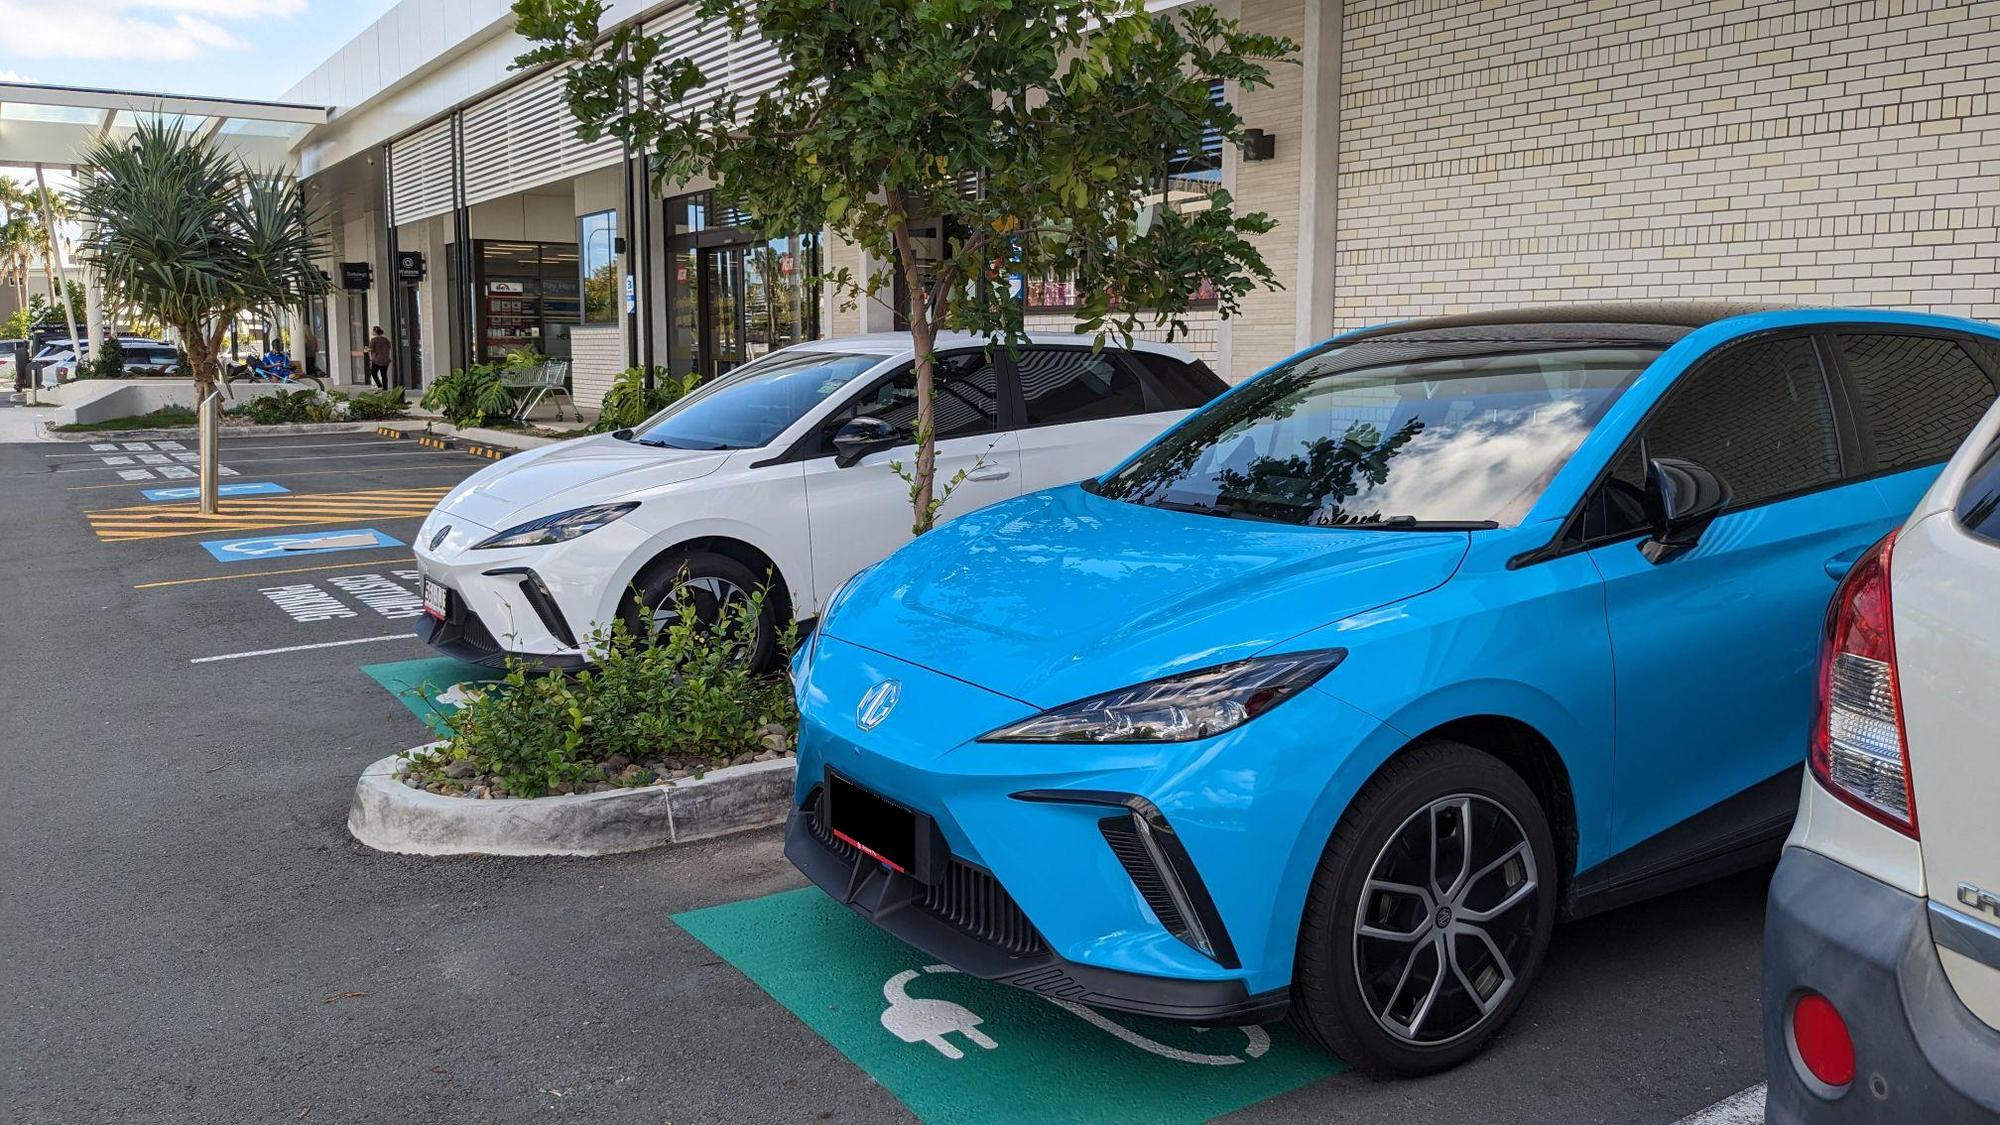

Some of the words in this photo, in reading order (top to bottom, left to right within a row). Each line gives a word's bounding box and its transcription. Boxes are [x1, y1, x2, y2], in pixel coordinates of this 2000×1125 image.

[257, 583, 359, 622] PARKING
[326, 573, 425, 620] CUSTOMER
[858, 680, 900, 729] MG
